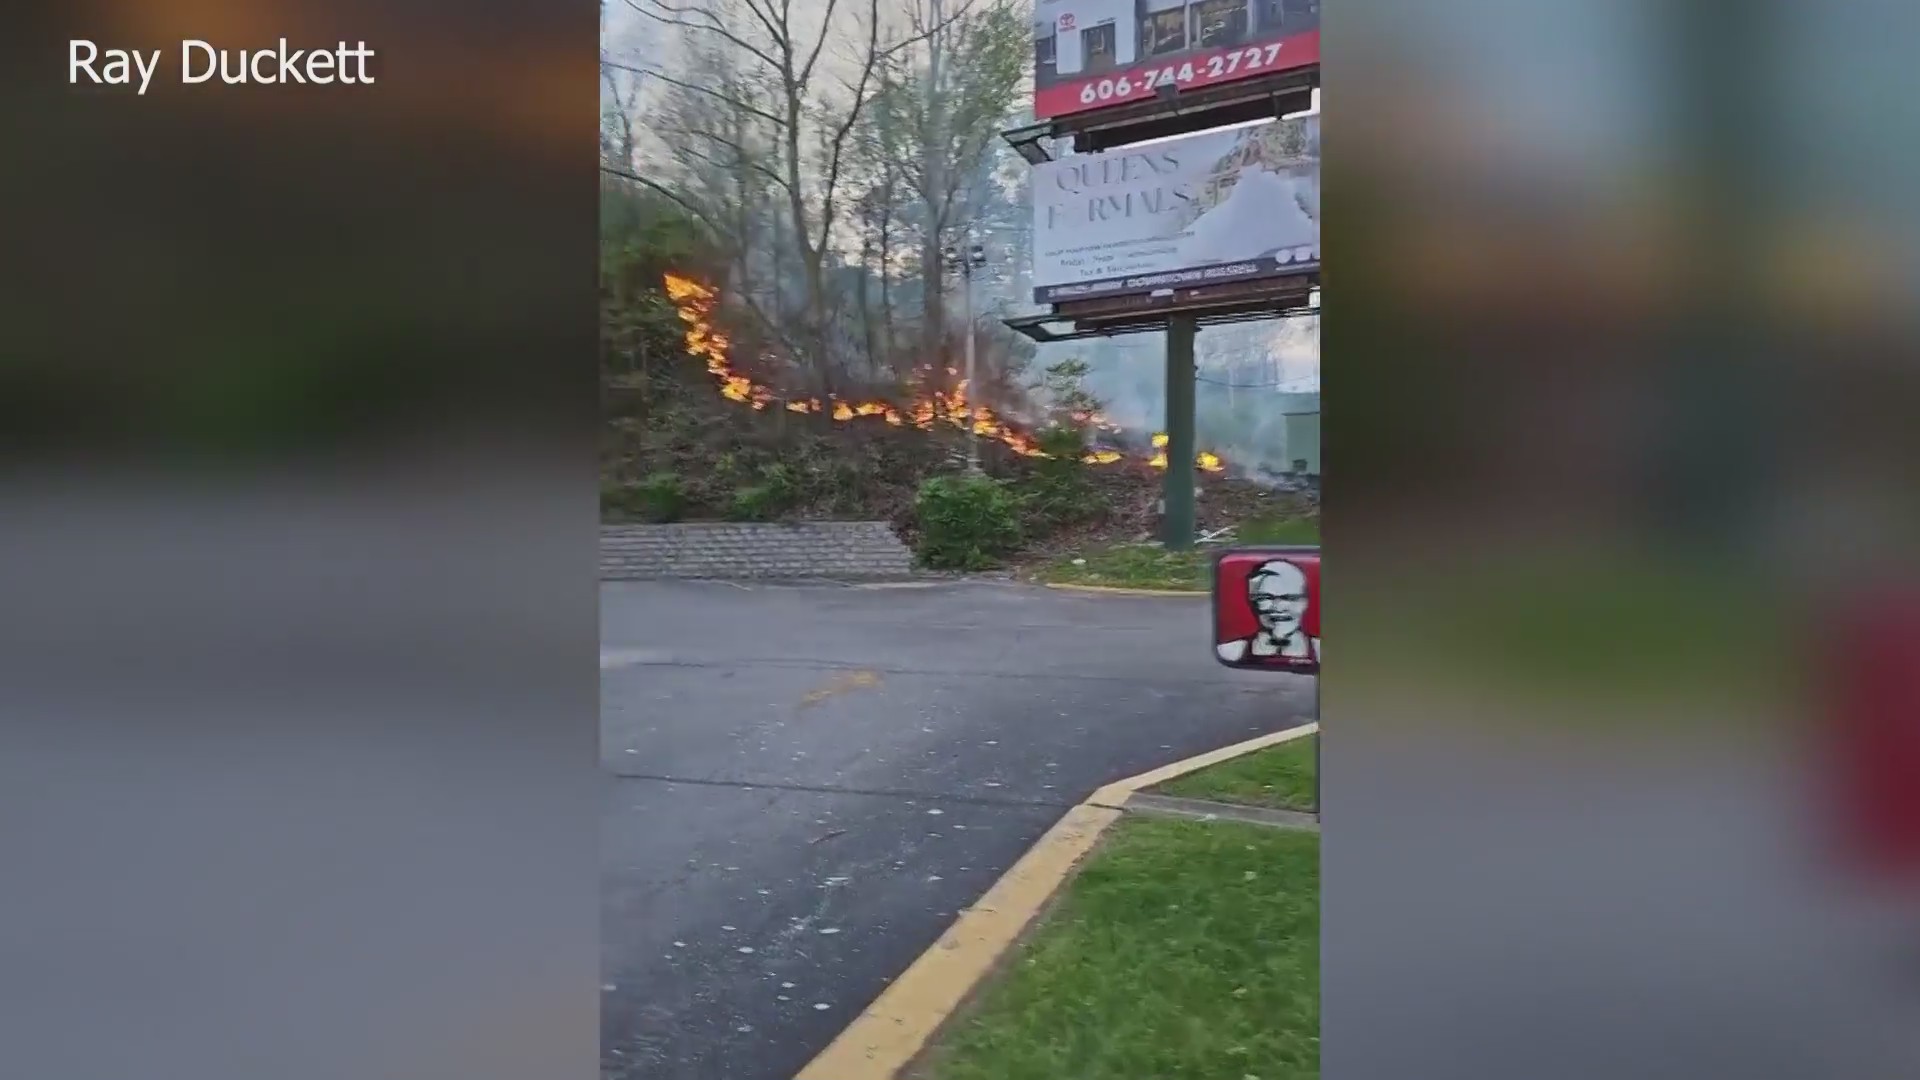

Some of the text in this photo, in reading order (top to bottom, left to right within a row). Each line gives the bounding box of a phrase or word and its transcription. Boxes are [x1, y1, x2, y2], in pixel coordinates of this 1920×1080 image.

[1079, 42, 1284, 105] 606-744-2727
[1056, 151, 1180, 194] QUEENS
[1047, 183, 1191, 229] FRMALS
